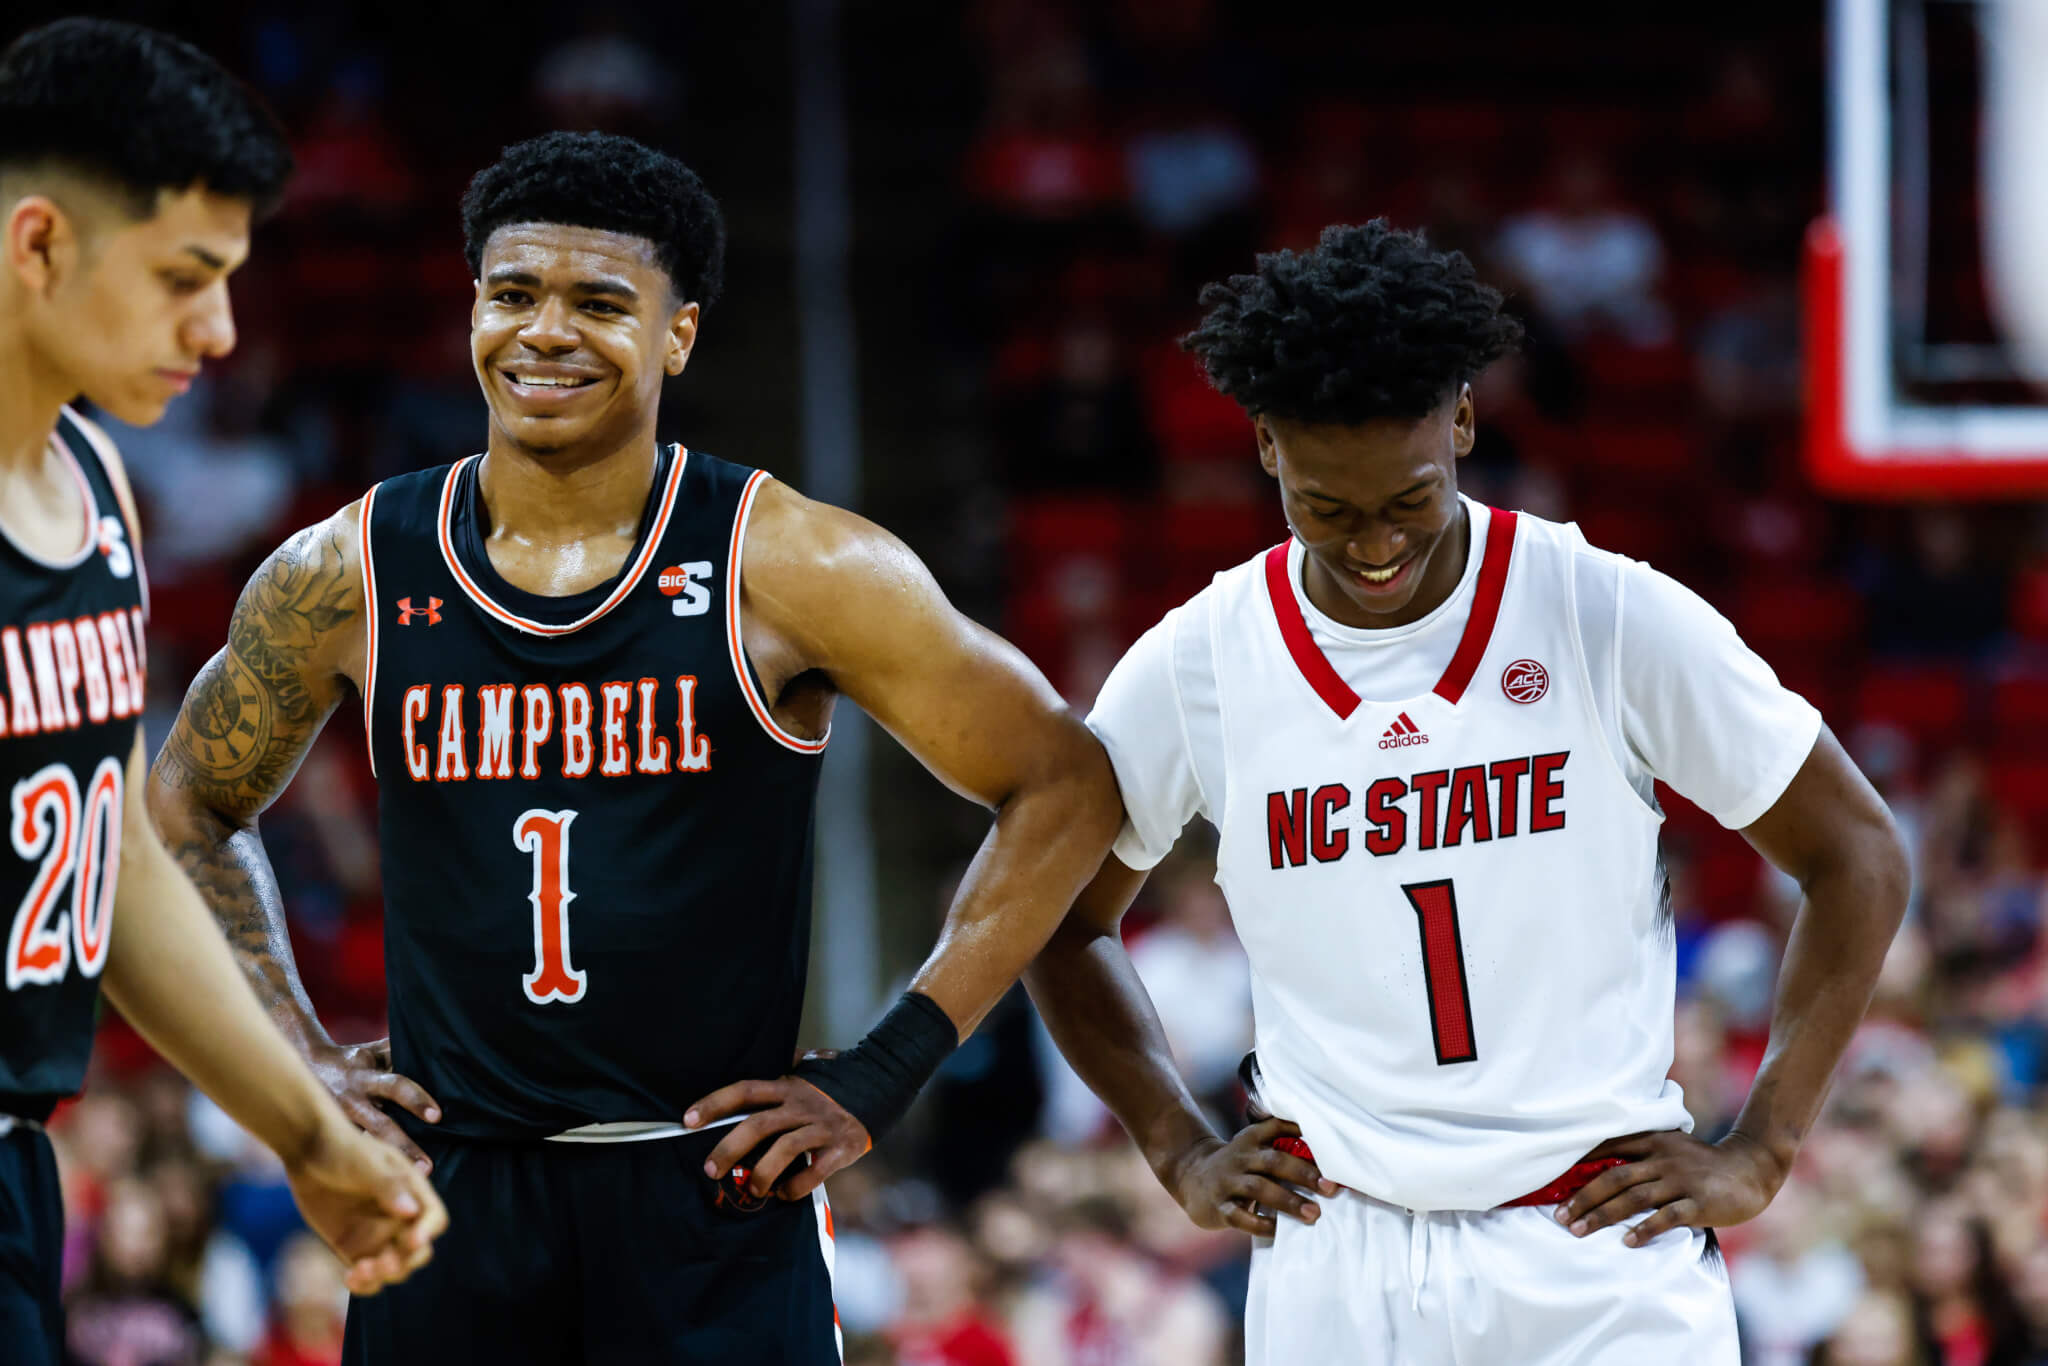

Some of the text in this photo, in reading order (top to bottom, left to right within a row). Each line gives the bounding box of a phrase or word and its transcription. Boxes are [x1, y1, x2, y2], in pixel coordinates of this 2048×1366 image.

[658, 574, 687, 588] BIG
[401, 674, 712, 782] CAMPBELL
[1508, 672, 1545, 688] ACC
[1378, 733, 1429, 750] adidas
[1267, 750, 1571, 870] NC STATE
[6, 757, 124, 991] 20
[512, 808, 588, 1006] 1
[1400, 877, 1479, 1067] 1
